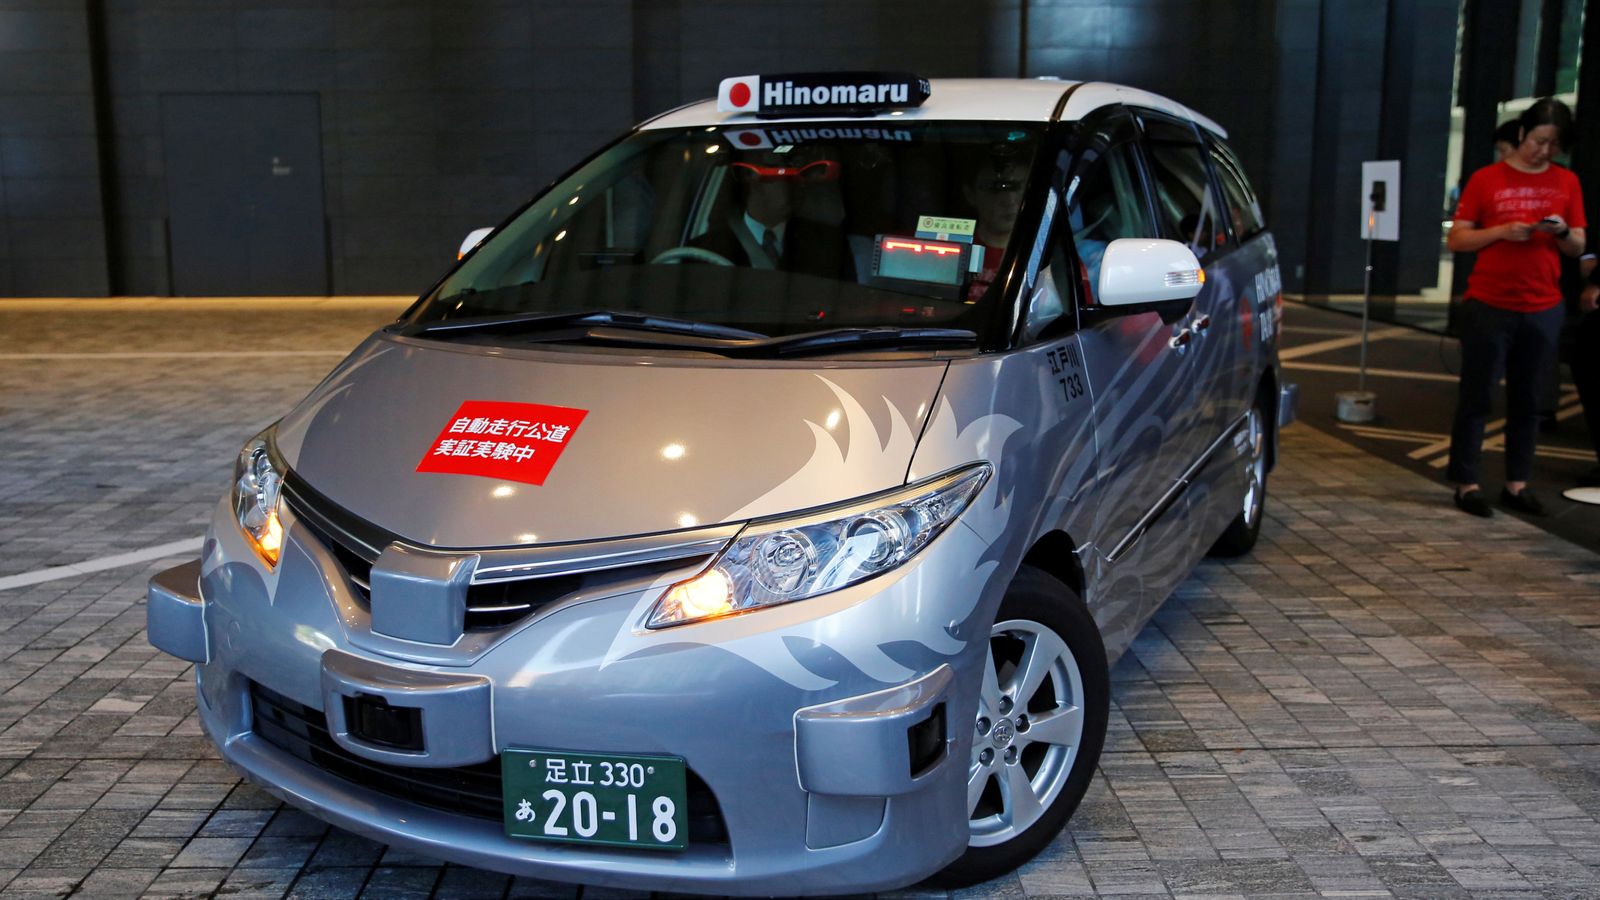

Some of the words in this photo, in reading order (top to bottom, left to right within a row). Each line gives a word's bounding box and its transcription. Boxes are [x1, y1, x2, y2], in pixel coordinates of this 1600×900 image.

[764, 81, 909, 106] Hinomaru
[1046, 343, 1080, 376] 江戸川
[1059, 373, 1084, 402] 733
[449, 416, 570, 443] 自動走行公道
[433, 438, 535, 463] 実証実験中
[545, 758, 594, 785] 足立
[600, 761, 645, 788] 330
[515, 798, 536, 822] あ
[542, 789, 677, 842] 20-18
